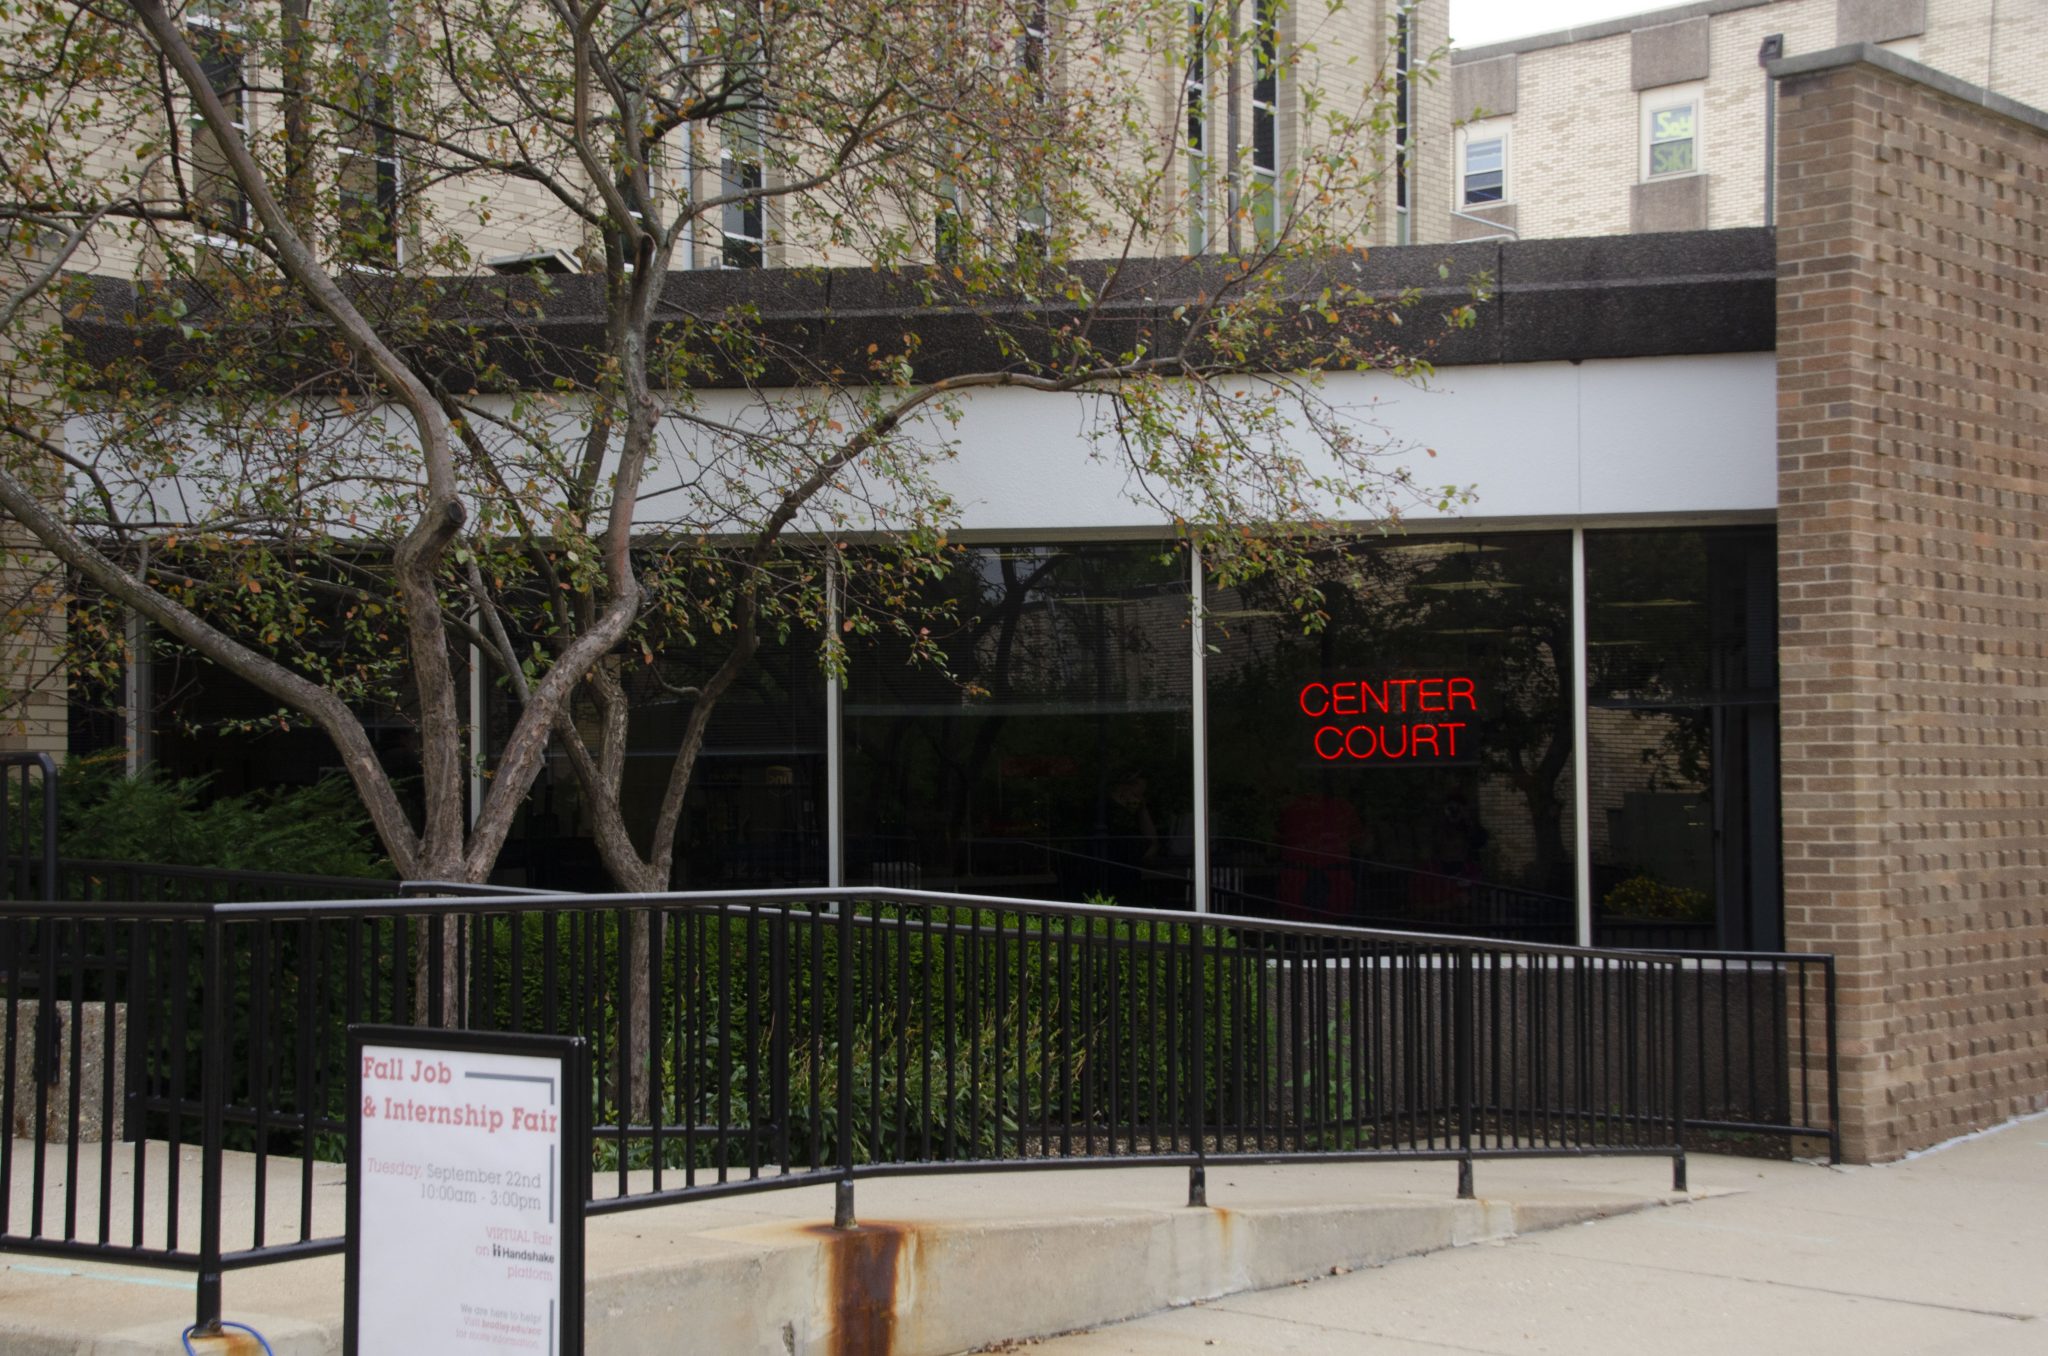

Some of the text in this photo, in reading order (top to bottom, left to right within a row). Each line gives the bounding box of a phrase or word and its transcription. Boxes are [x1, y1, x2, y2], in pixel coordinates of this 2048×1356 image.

[1655, 112, 1694, 138] Say
[1300, 677, 1478, 717] CENTER
[1314, 722, 1467, 760] COURT
[363, 1057, 452, 1084] Fall Job
[363, 1096, 557, 1133] & Internship Fair
[427, 1163, 501, 1184] September
[506, 1171, 541, 1188] 22nd
[420, 1183, 477, 1204] 10:00am
[490, 1190, 541, 1211] 3:00pm
[486, 1226, 552, 1245] VIRTUAL Fair
[503, 1247, 555, 1264] Handshake
[507, 1266, 553, 1281] platform
